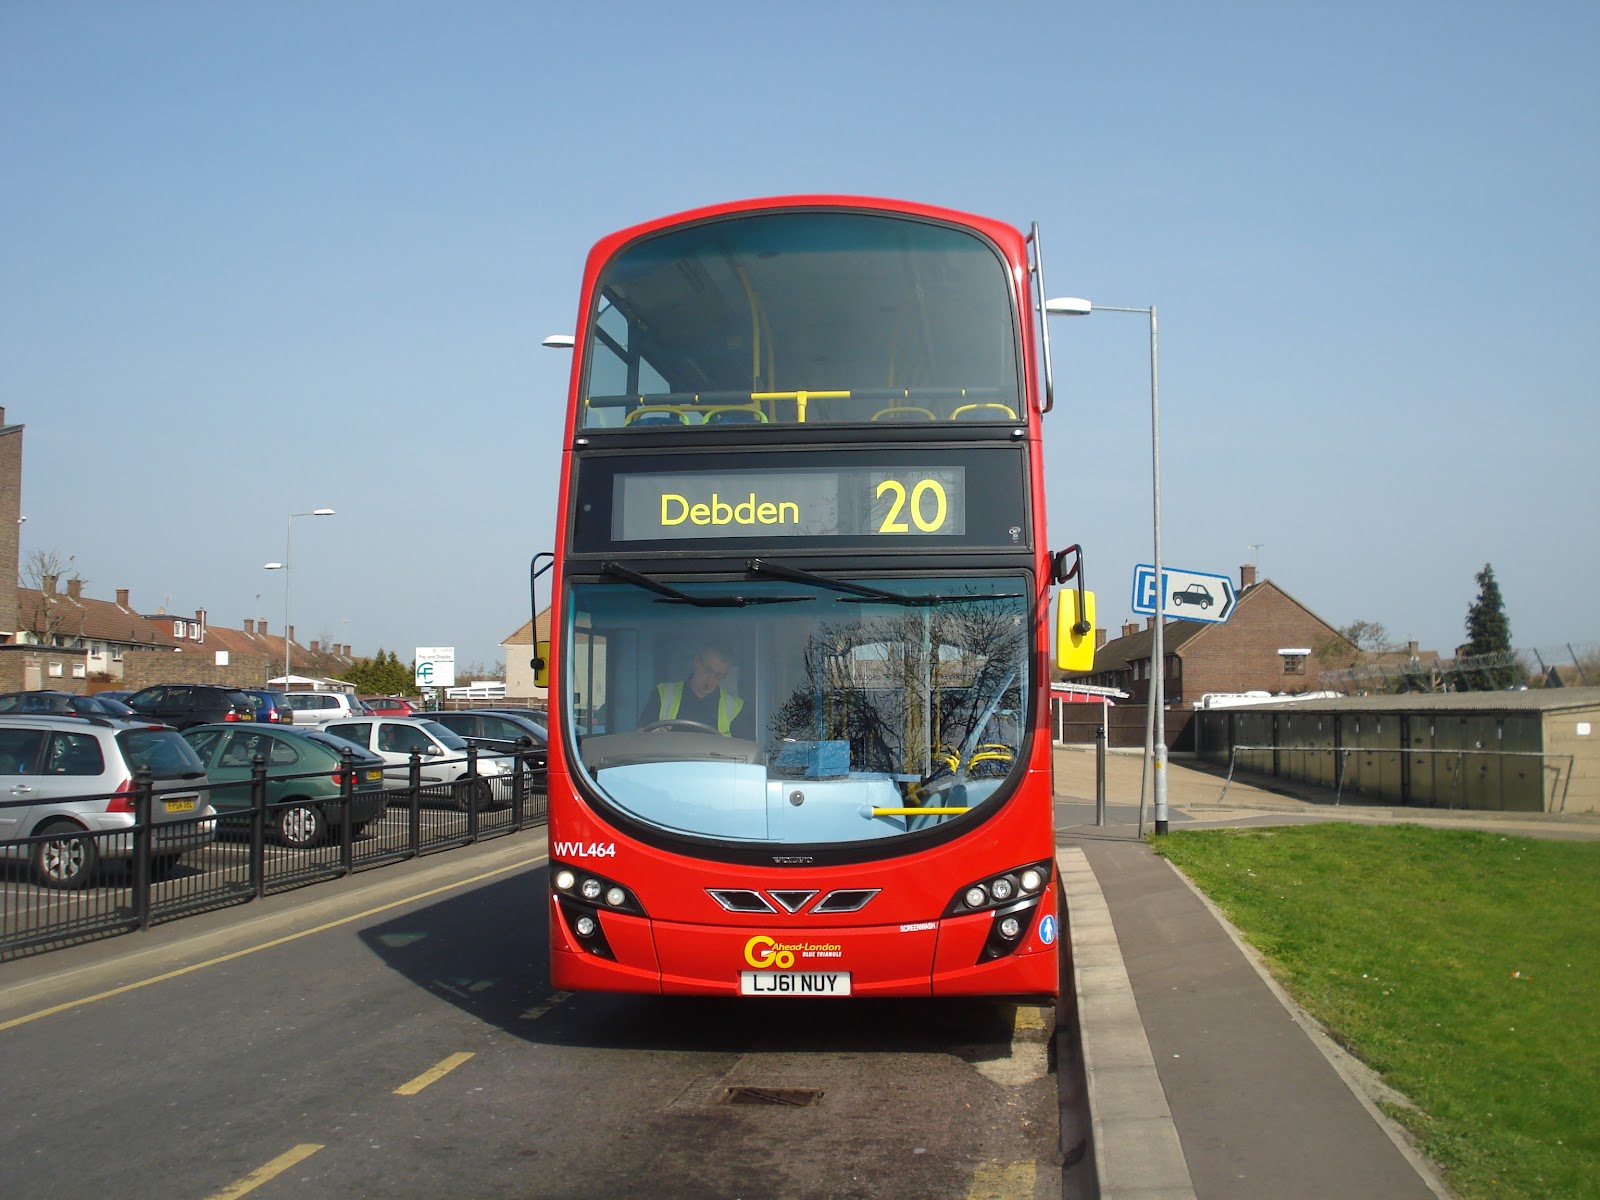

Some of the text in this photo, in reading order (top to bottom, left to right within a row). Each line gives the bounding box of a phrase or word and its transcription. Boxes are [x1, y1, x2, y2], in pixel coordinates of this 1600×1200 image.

[661, 479, 947, 533] Debden 20
[553, 841, 616, 858] WVL464
[744, 935, 841, 969] Go Ahead-London
[753, 974, 838, 992] LJ61 NUY
